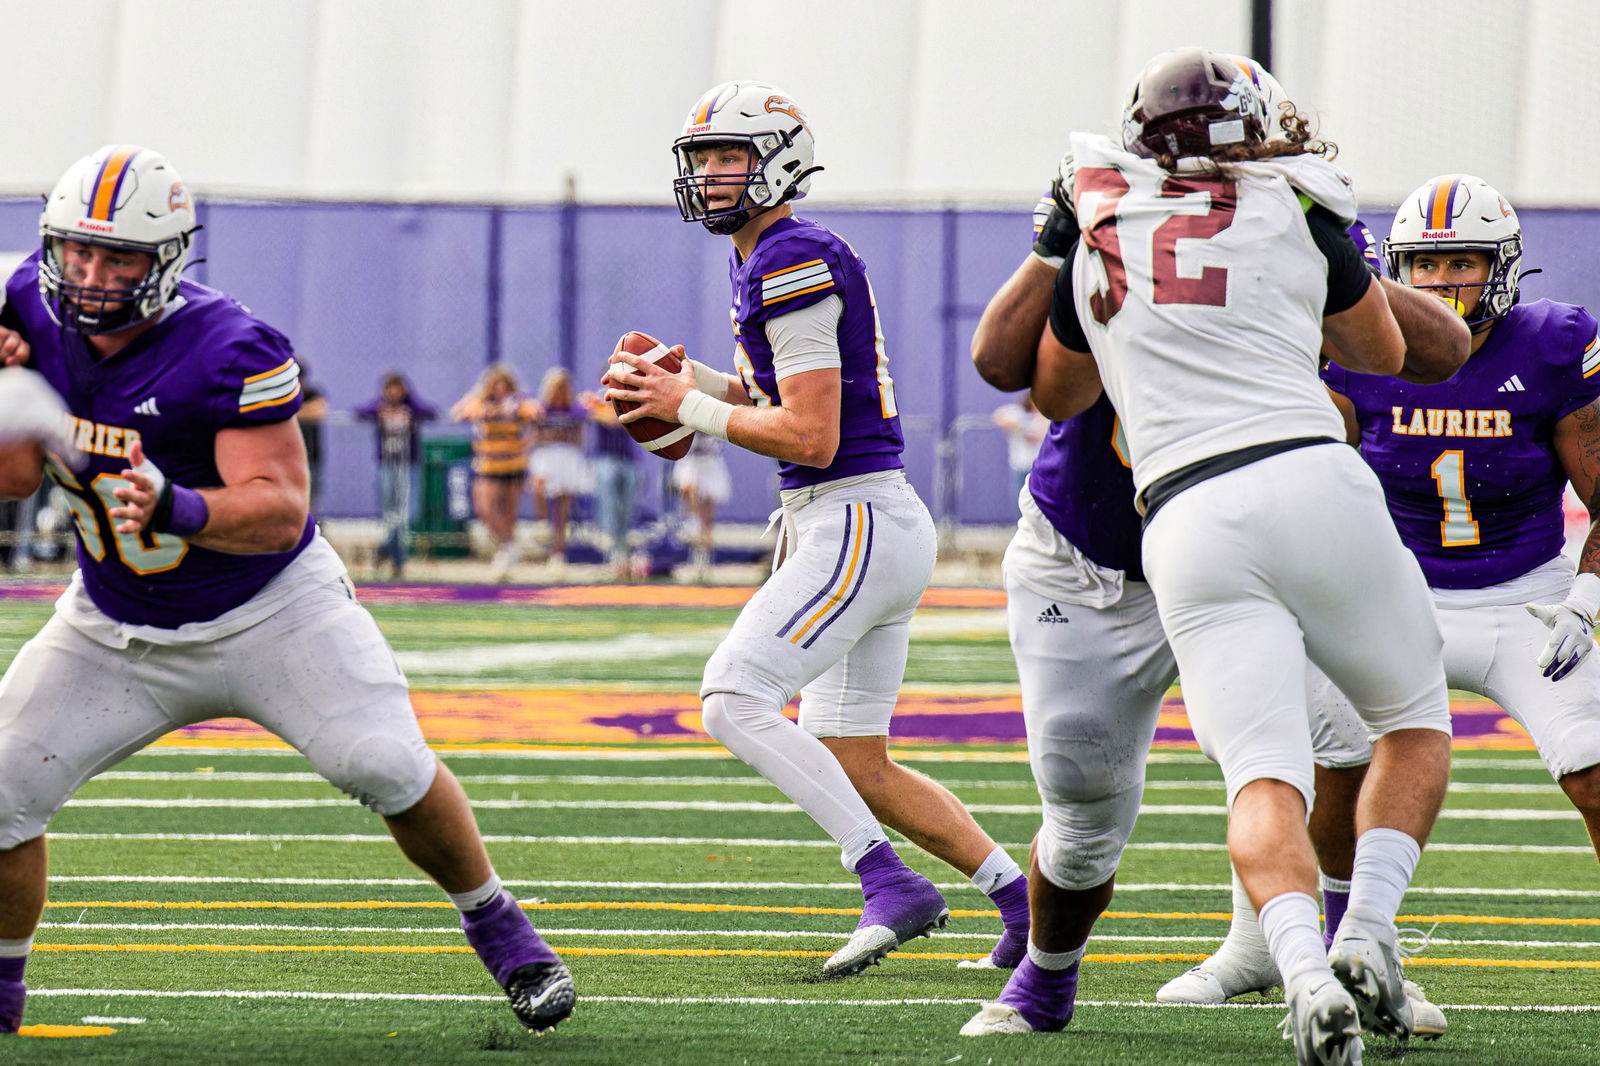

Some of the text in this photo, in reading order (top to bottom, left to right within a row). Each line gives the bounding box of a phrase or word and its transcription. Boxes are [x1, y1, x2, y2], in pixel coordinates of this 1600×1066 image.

[1421, 230, 1456, 239] Riddell
[1391, 406, 1513, 438] LAURIER
[1430, 449, 1481, 548] 1
[1036, 615, 1069, 624] adidas
